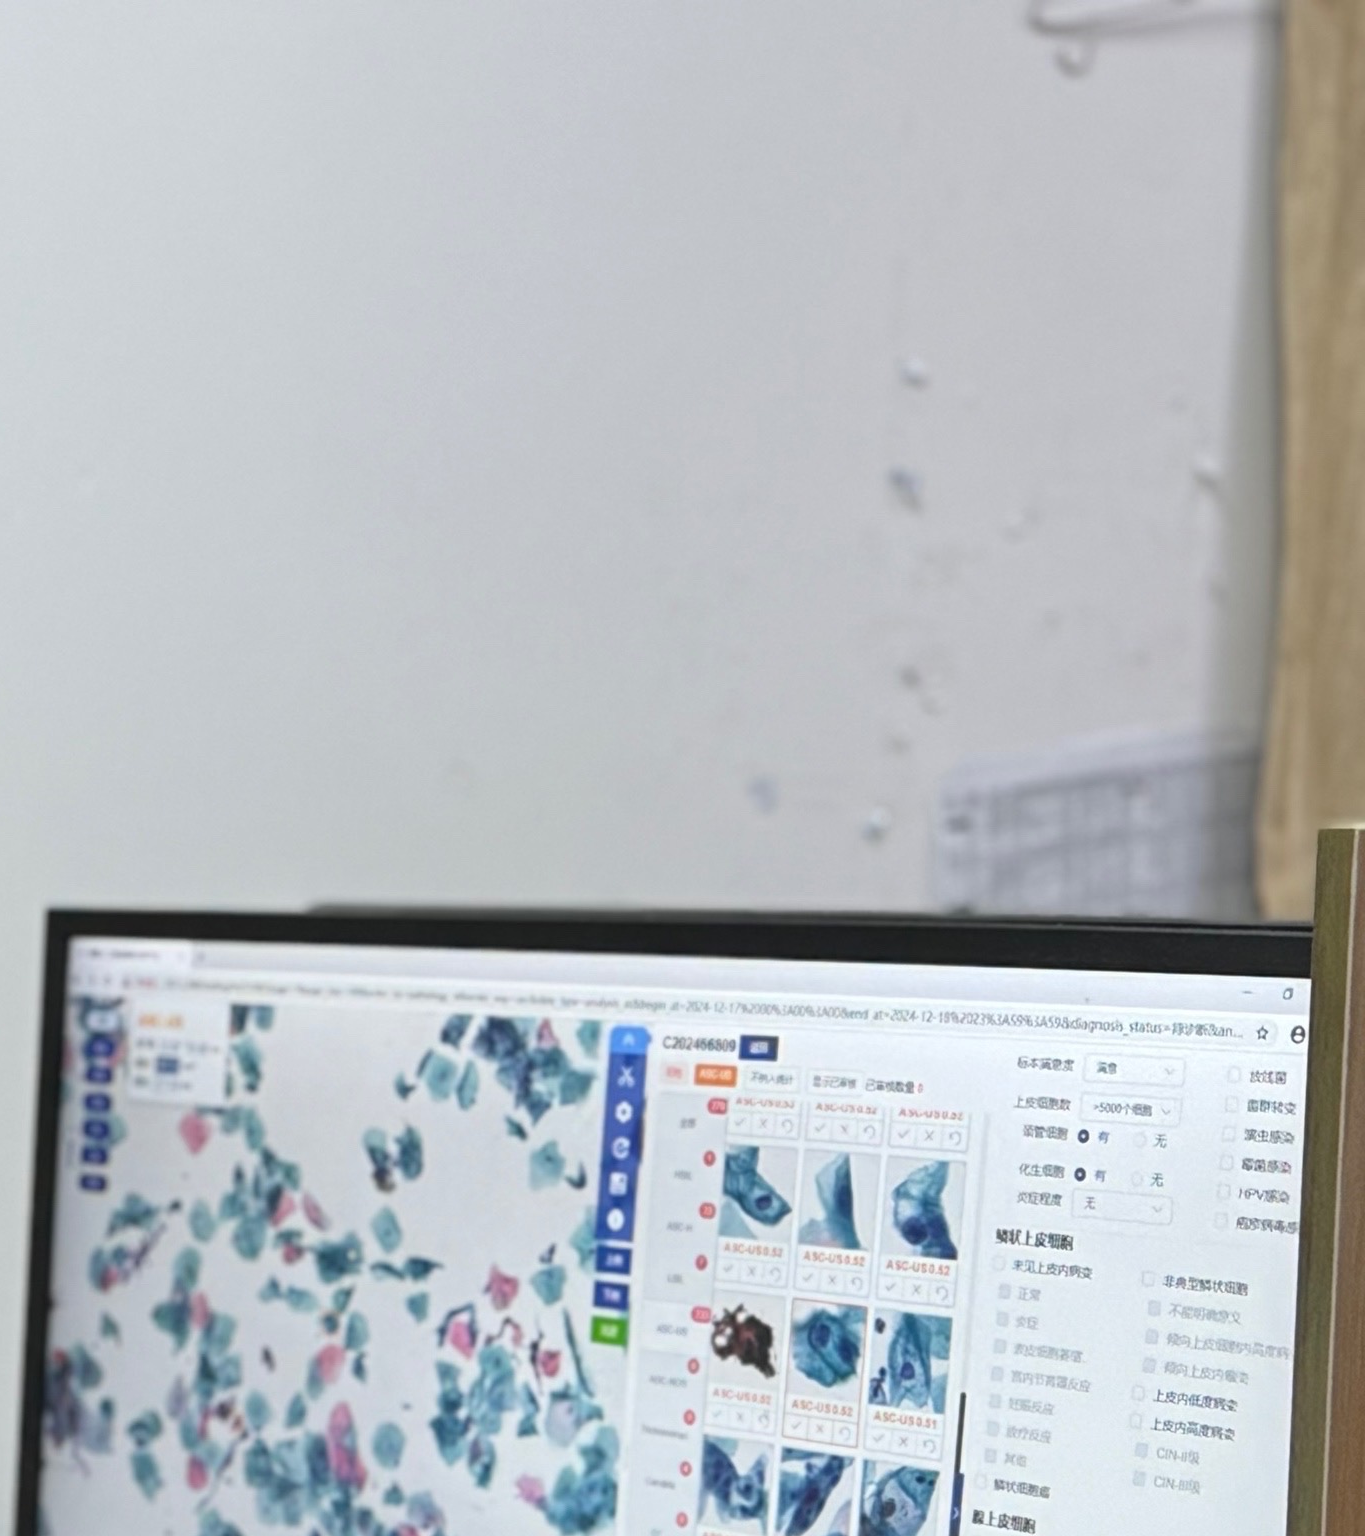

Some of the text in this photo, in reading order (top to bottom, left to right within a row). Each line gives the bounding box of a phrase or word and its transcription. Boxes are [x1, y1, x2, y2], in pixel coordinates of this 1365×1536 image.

[1154, 1134, 1167, 1149] 无
[1150, 1173, 1164, 1188] 无
[1084, 1195, 1096, 1211] 无
[996, 1228, 1074, 1251] 鳞状上皮细胞
[803, 1251, 844, 1265] ASC-US
[885, 1259, 927, 1274] ASC-US
[1012, 1259, 1094, 1280] 未见上皮内病变
[1162, 1274, 1249, 1297] 非典型鳞状细胞
[1017, 1287, 1042, 1302] 正常
[791, 1399, 831, 1414] ASC-US
[1153, 1388, 1238, 1413] 上皮内低度病变
[873, 1411, 914, 1426] ASC-US
[1150, 1416, 1236, 1443] 上皮内高度病变
[994, 1478, 1051, 1500] 鳞状细胞癌
[972, 1508, 1036, 1535] 腺上皮细胞
